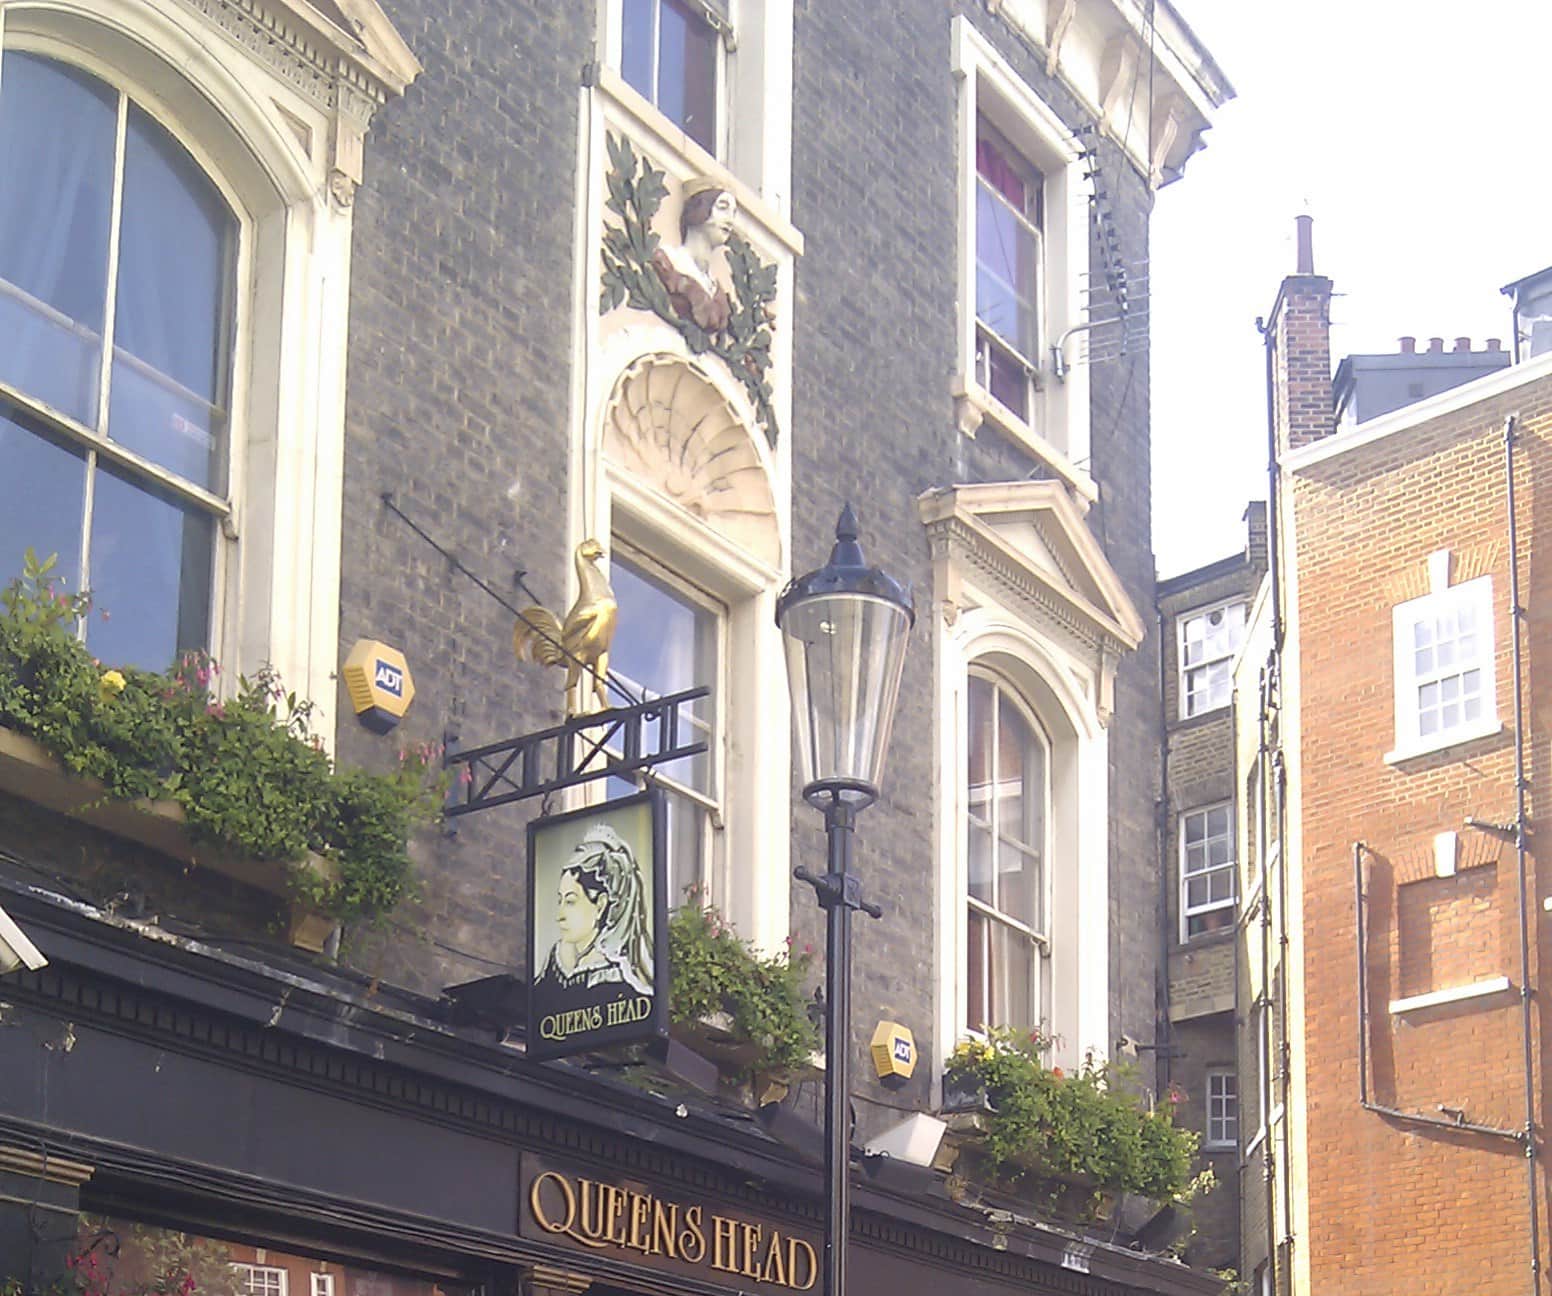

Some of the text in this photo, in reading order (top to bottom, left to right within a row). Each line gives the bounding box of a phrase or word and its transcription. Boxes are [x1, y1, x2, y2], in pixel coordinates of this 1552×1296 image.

[375, 666, 403, 691] ADT
[540, 994, 652, 1041] QUEENS HEAD
[894, 1042, 911, 1060] ADT
[531, 1171, 818, 1291] QUEENS HEAD
